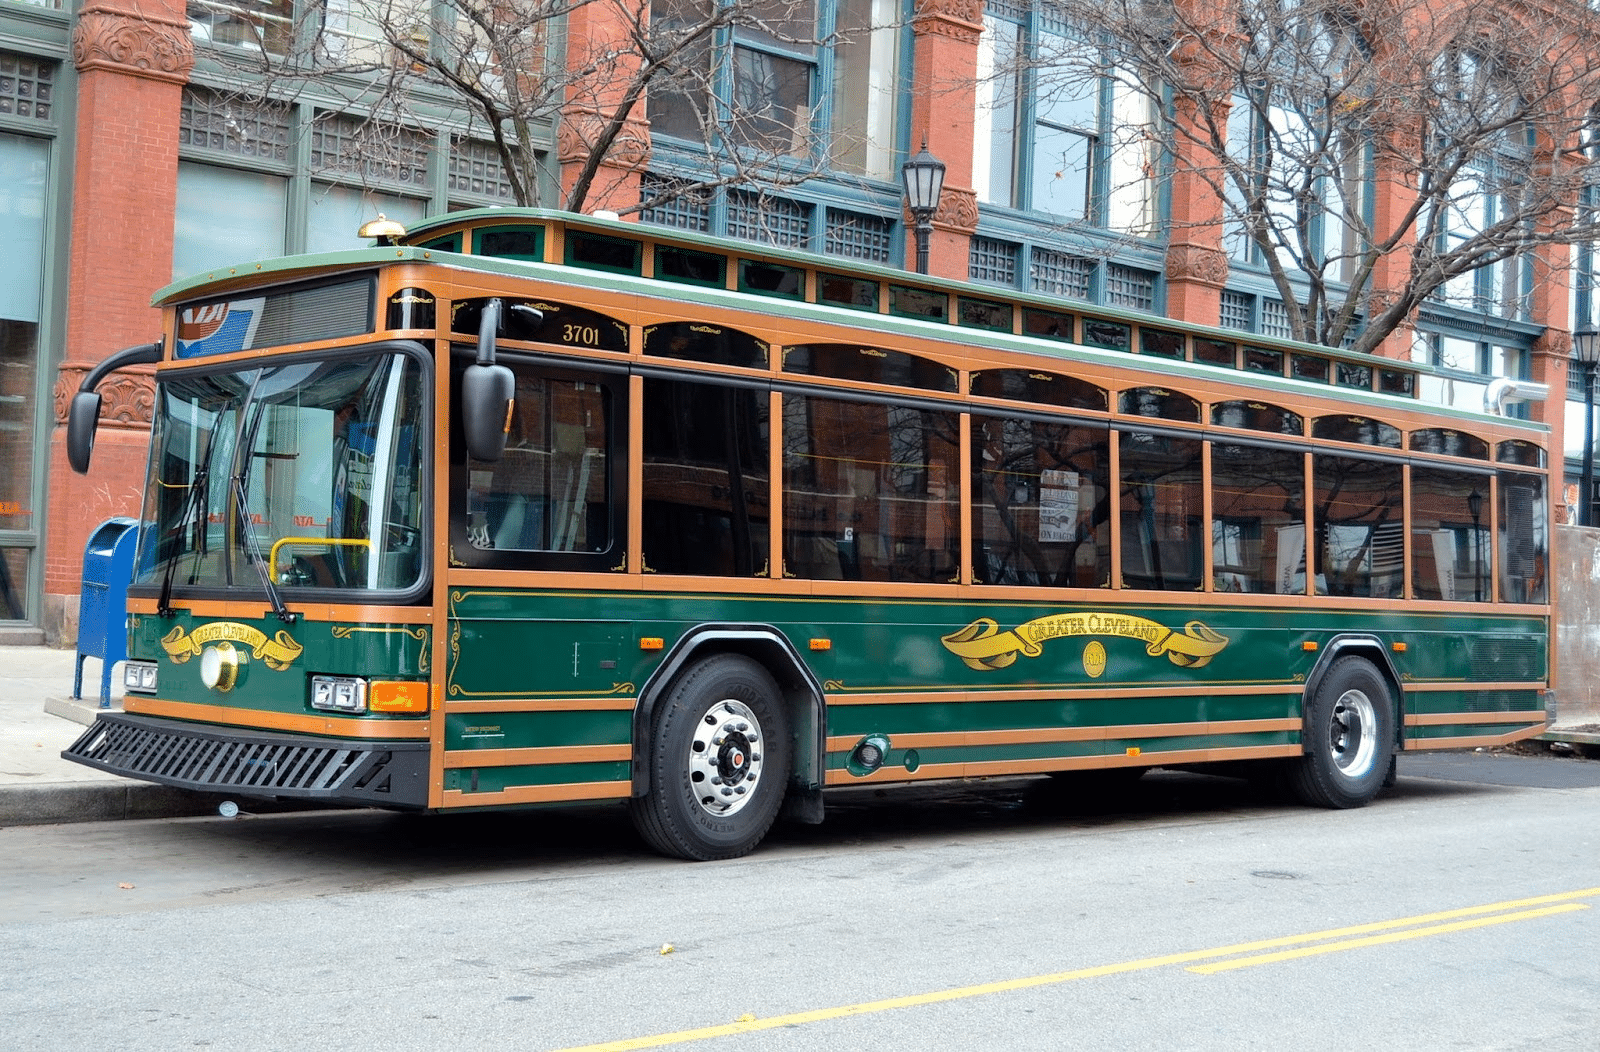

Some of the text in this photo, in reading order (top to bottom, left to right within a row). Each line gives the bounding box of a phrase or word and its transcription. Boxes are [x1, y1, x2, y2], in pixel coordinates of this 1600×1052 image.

[563, 324, 599, 346] 3701
[1027, 614, 1160, 643] GREATER CLEVELAND
